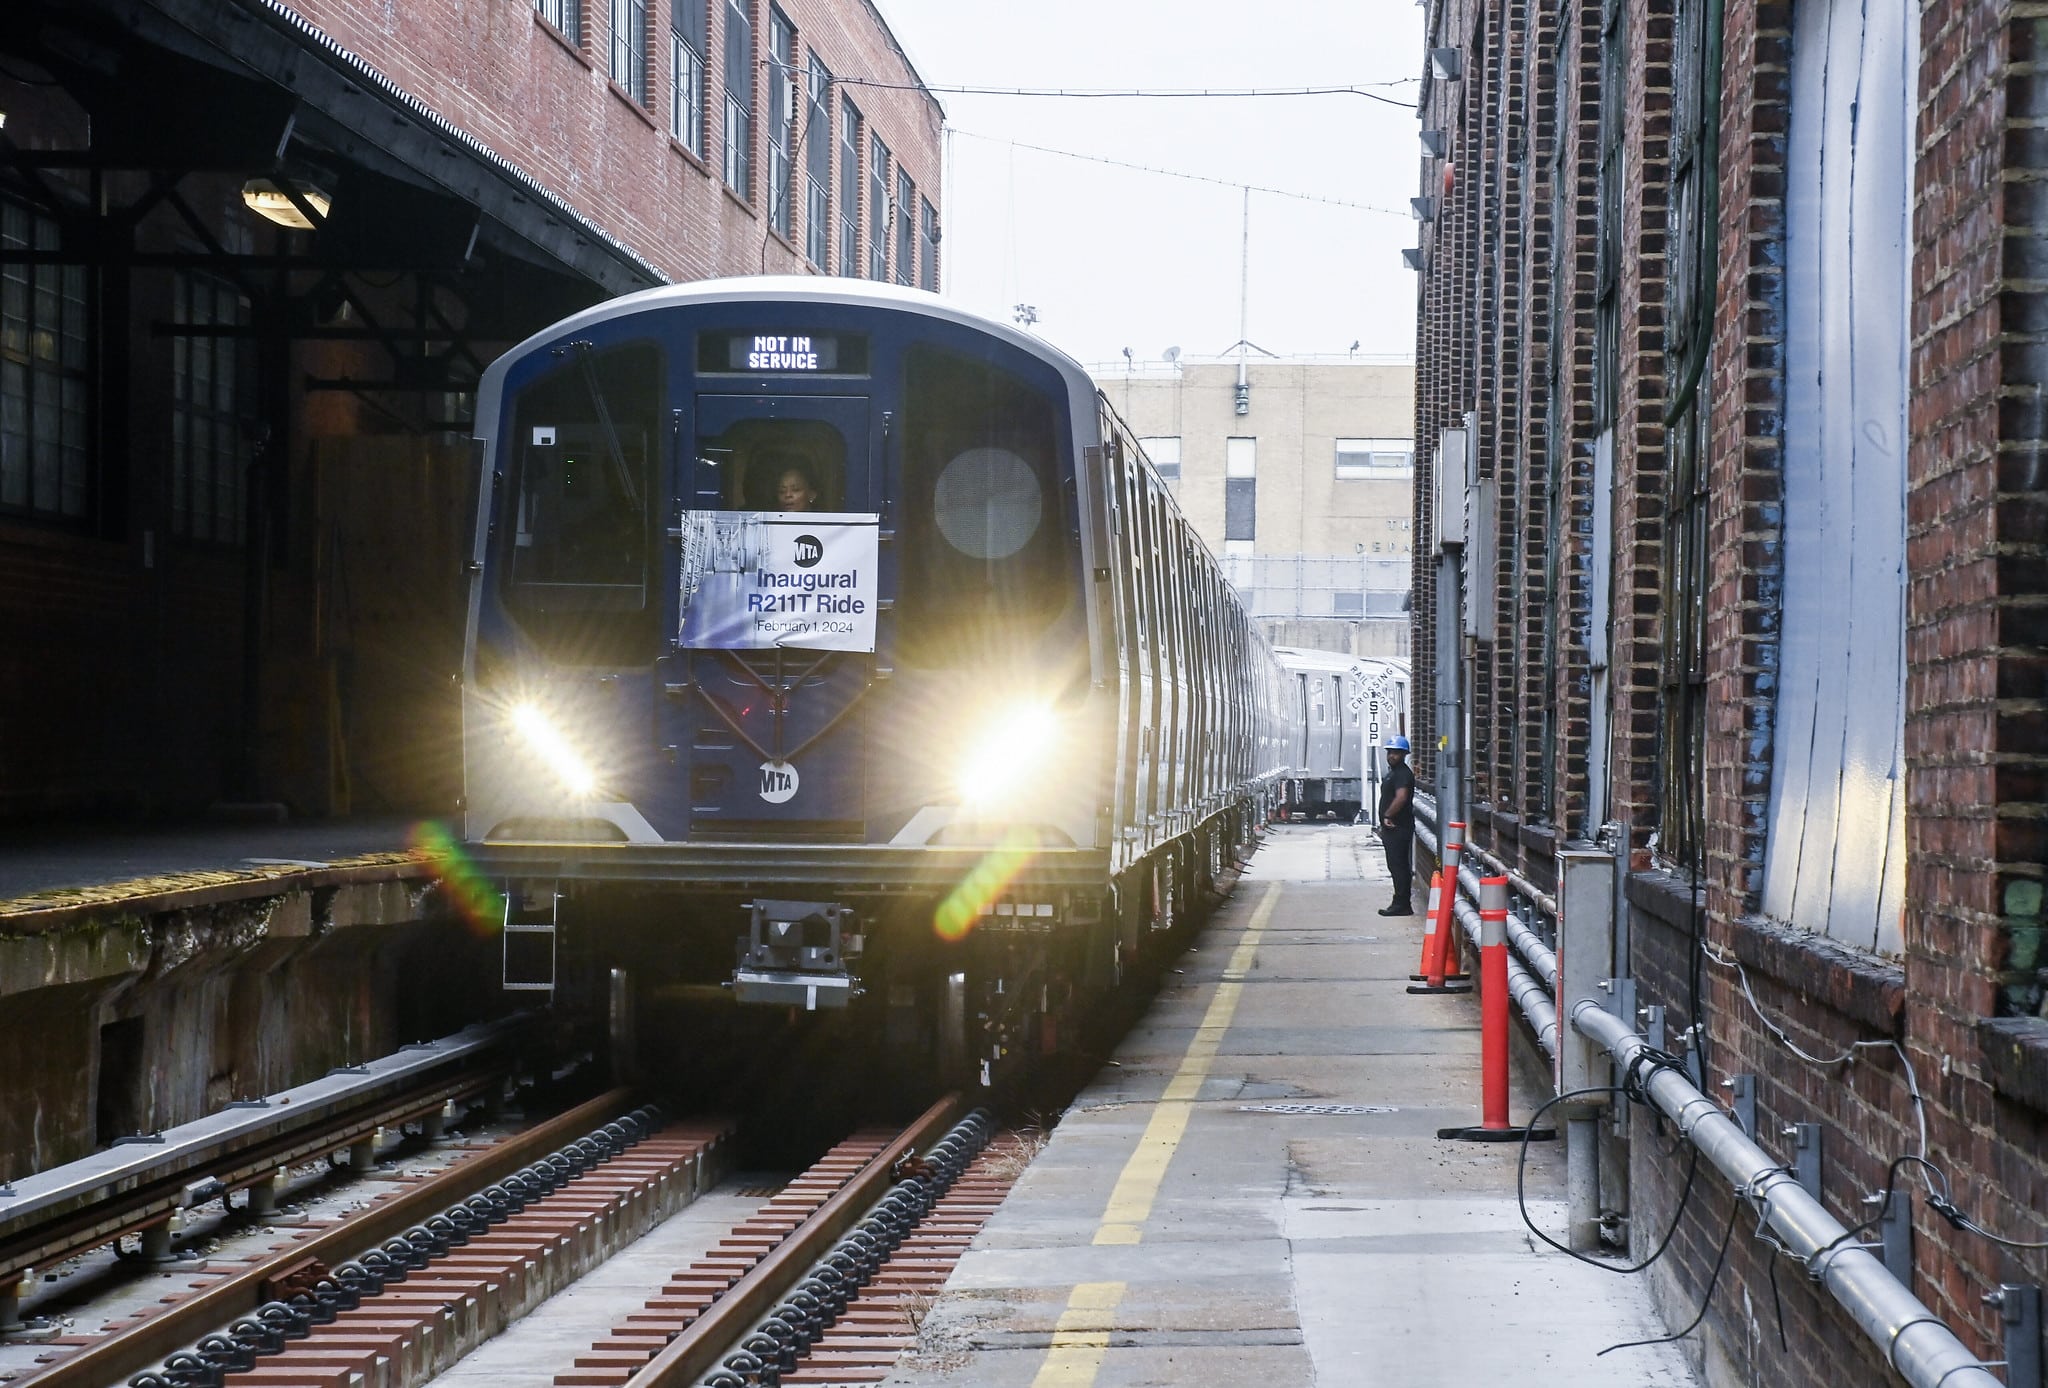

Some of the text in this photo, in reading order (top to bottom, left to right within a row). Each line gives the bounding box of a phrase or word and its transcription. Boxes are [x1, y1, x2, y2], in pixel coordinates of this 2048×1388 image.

[754, 336, 810, 352] NOT IN
[749, 352, 818, 369] SERVICE
[794, 541, 819, 561] MTA
[757, 568, 857, 592] Inaugural
[748, 593, 865, 614] R211T Ride
[757, 620, 810, 633] February
[822, 621, 853, 633] 2024
[1350, 665, 1368, 686] RAIL
[1351, 667, 1393, 710] CROSSING
[1369, 700, 1379, 744] STOP
[760, 769, 792, 794] MTA
